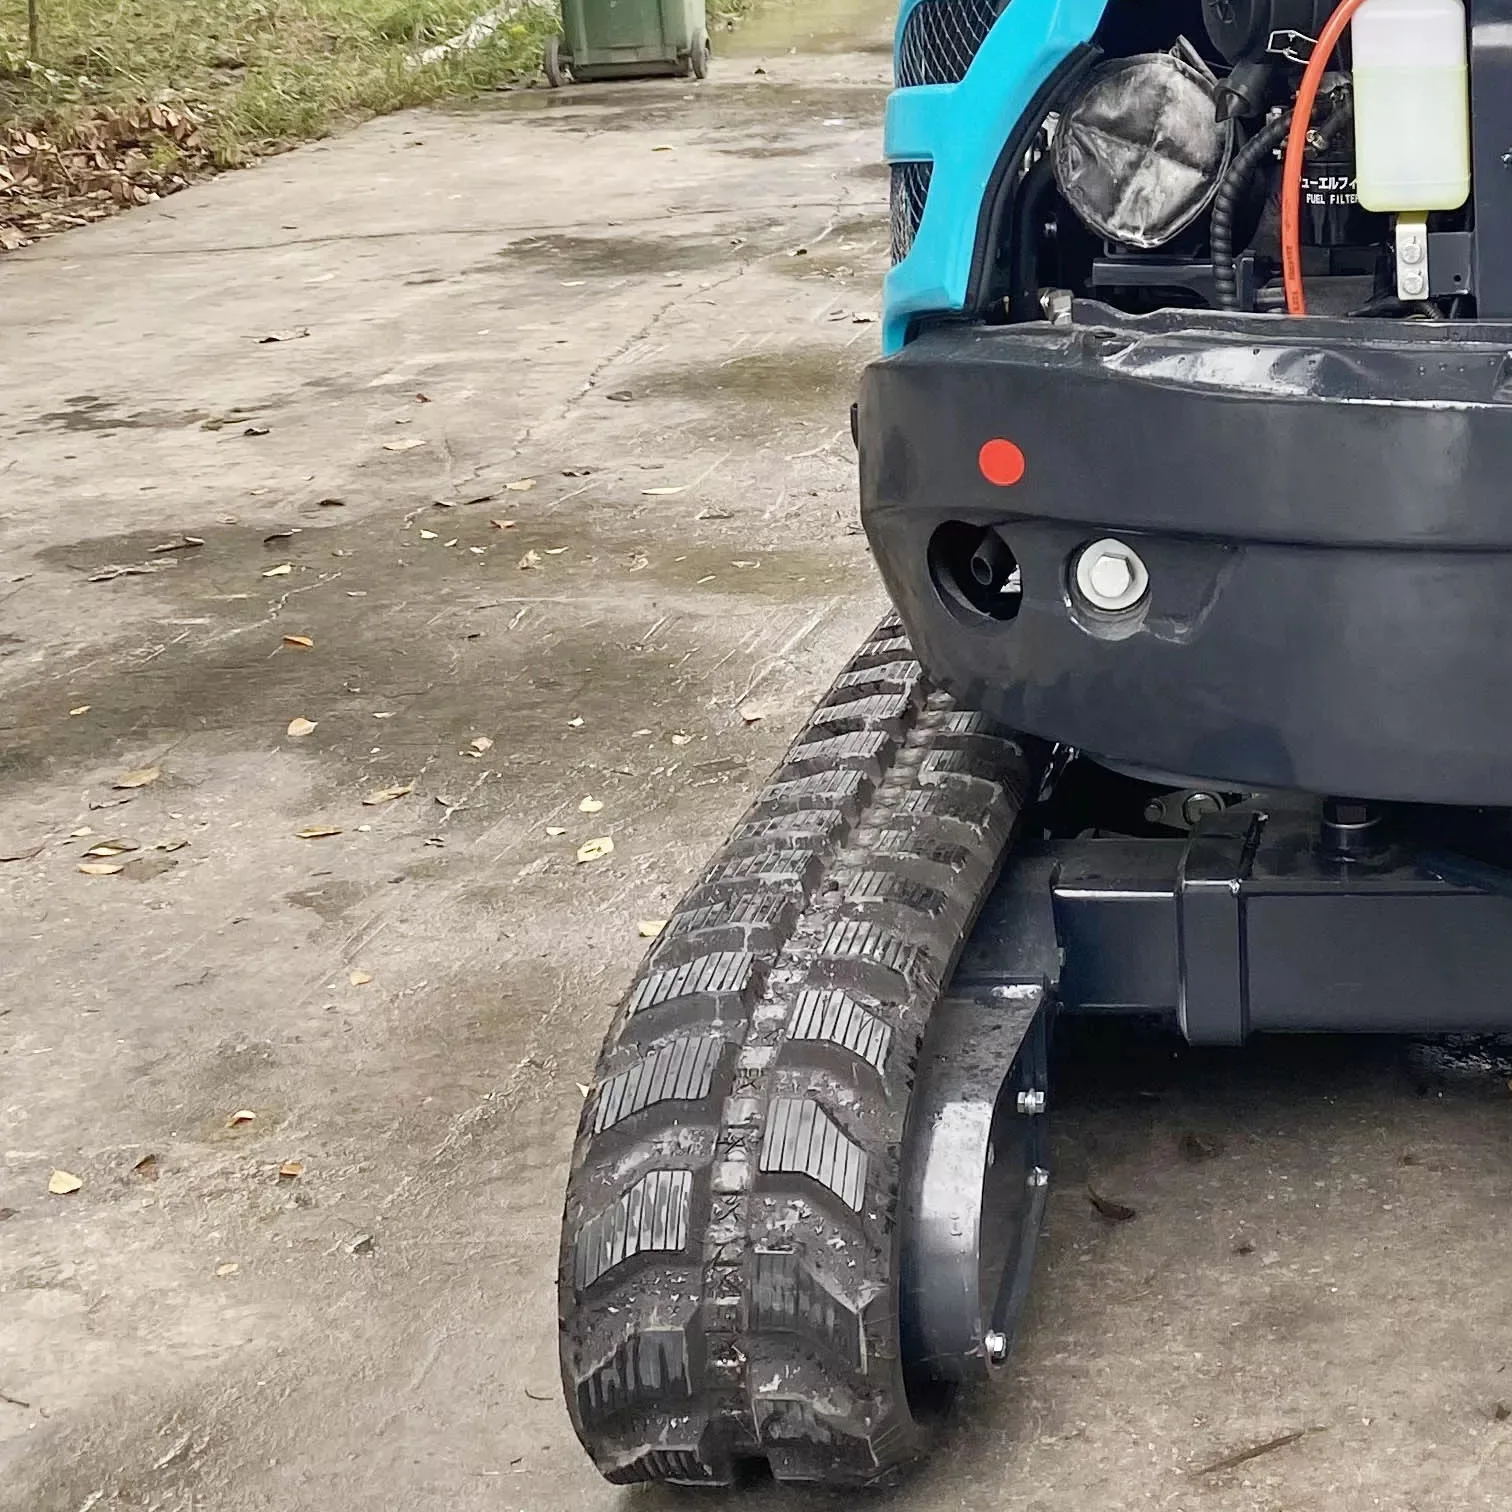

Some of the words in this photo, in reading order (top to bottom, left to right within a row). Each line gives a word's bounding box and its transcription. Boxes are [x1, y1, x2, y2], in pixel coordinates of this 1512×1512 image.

[1299, 176, 1357, 190] ューエルフィ
[1306, 193, 1326, 205] FUEL
